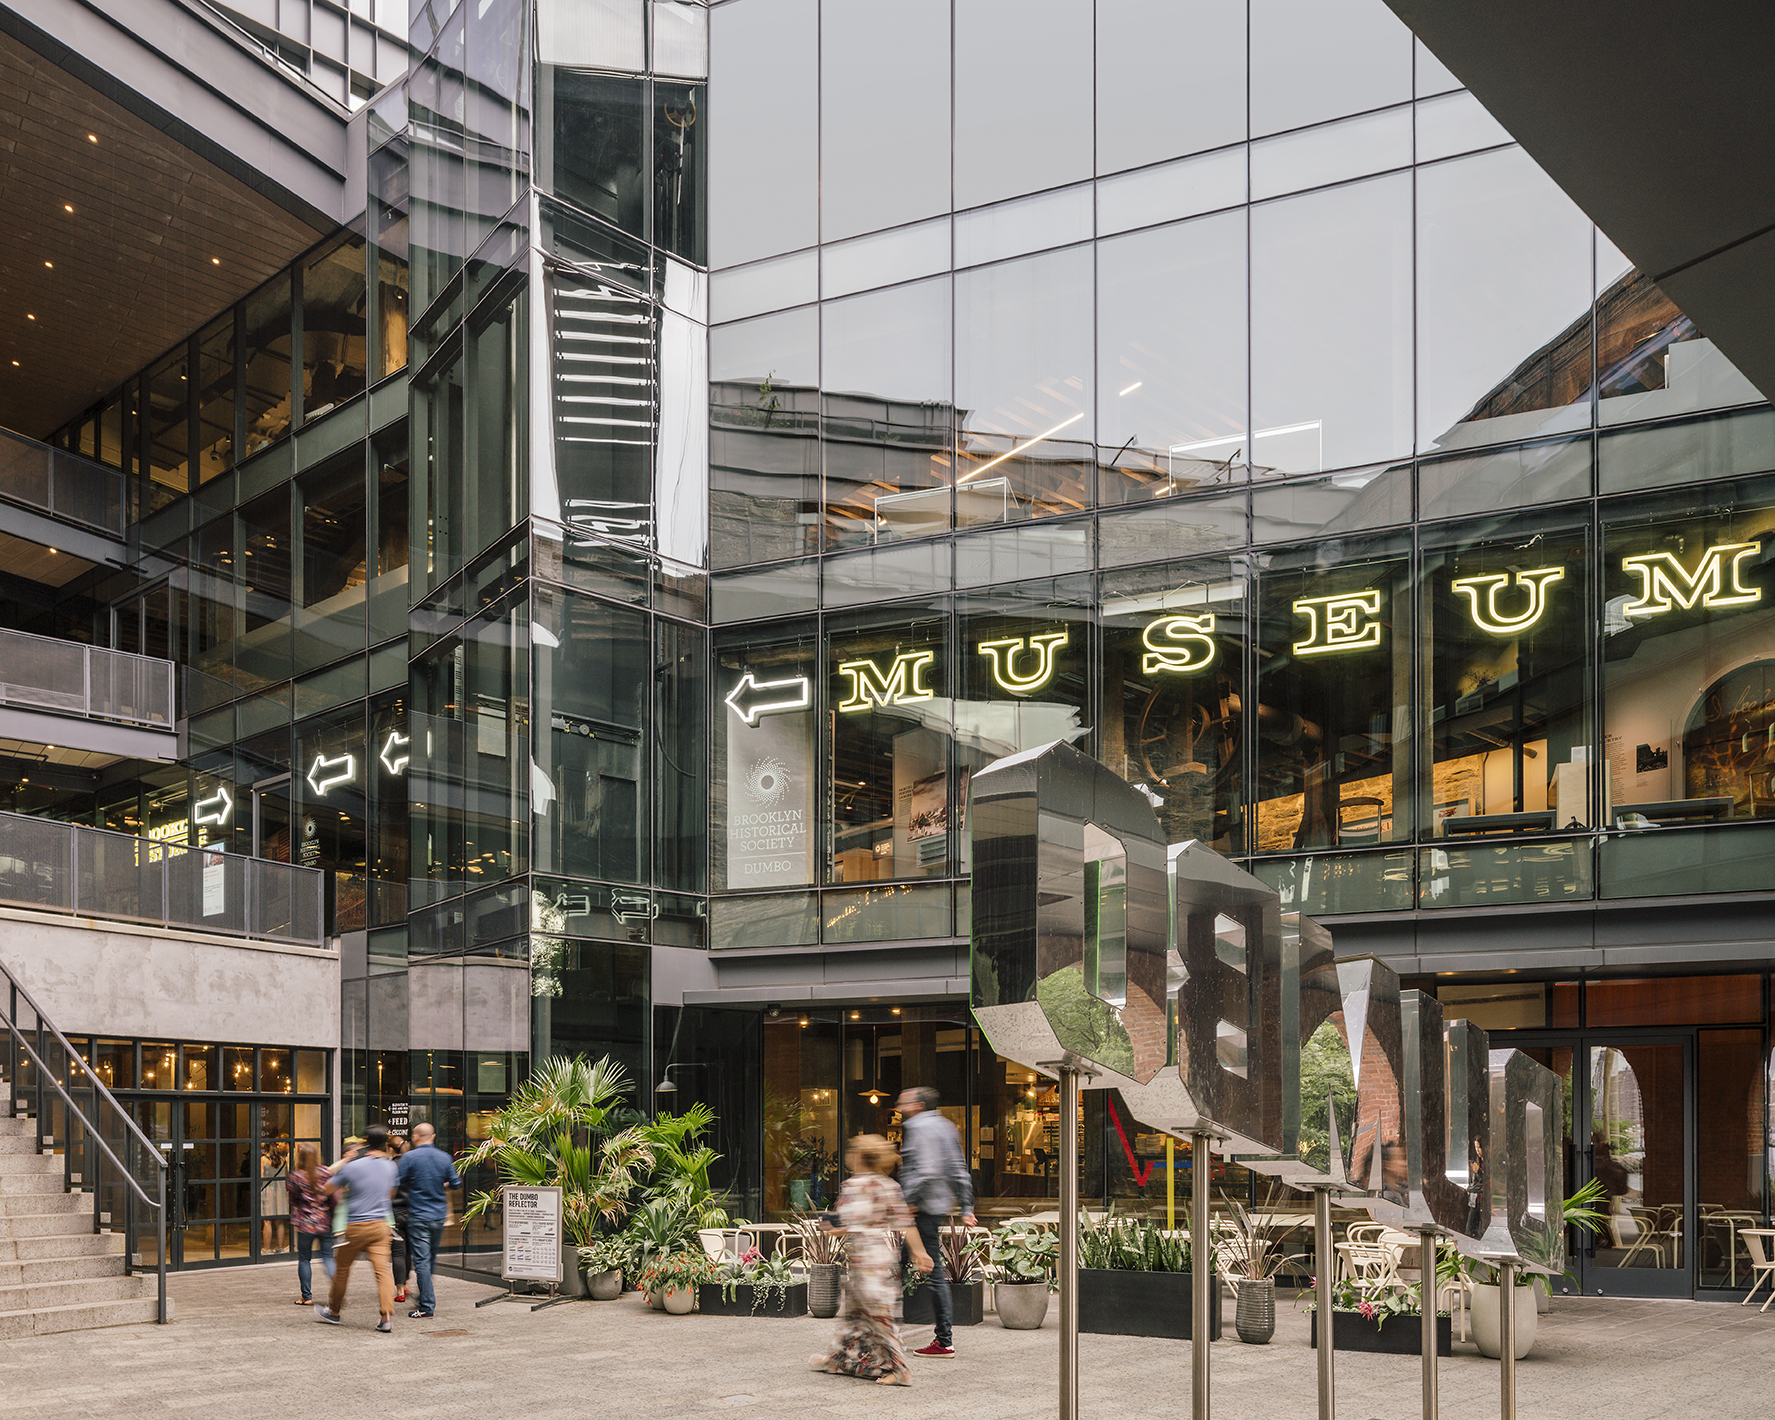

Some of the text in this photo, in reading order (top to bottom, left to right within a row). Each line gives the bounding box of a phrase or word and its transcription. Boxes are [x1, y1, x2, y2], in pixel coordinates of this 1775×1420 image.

[839, 540, 1762, 713] MUSEUM
[734, 809, 803, 826] BROOKLYN
[729, 822, 807, 839] HISTORICAL
[740, 836, 796, 852] SOCIETY
[744, 860, 792, 875] DUMBO
[392, 1117, 408, 1126] FEED
[508, 1192, 539, 1201] THE DUMBO
[508, 1200, 538, 1208] REFLECTOR
